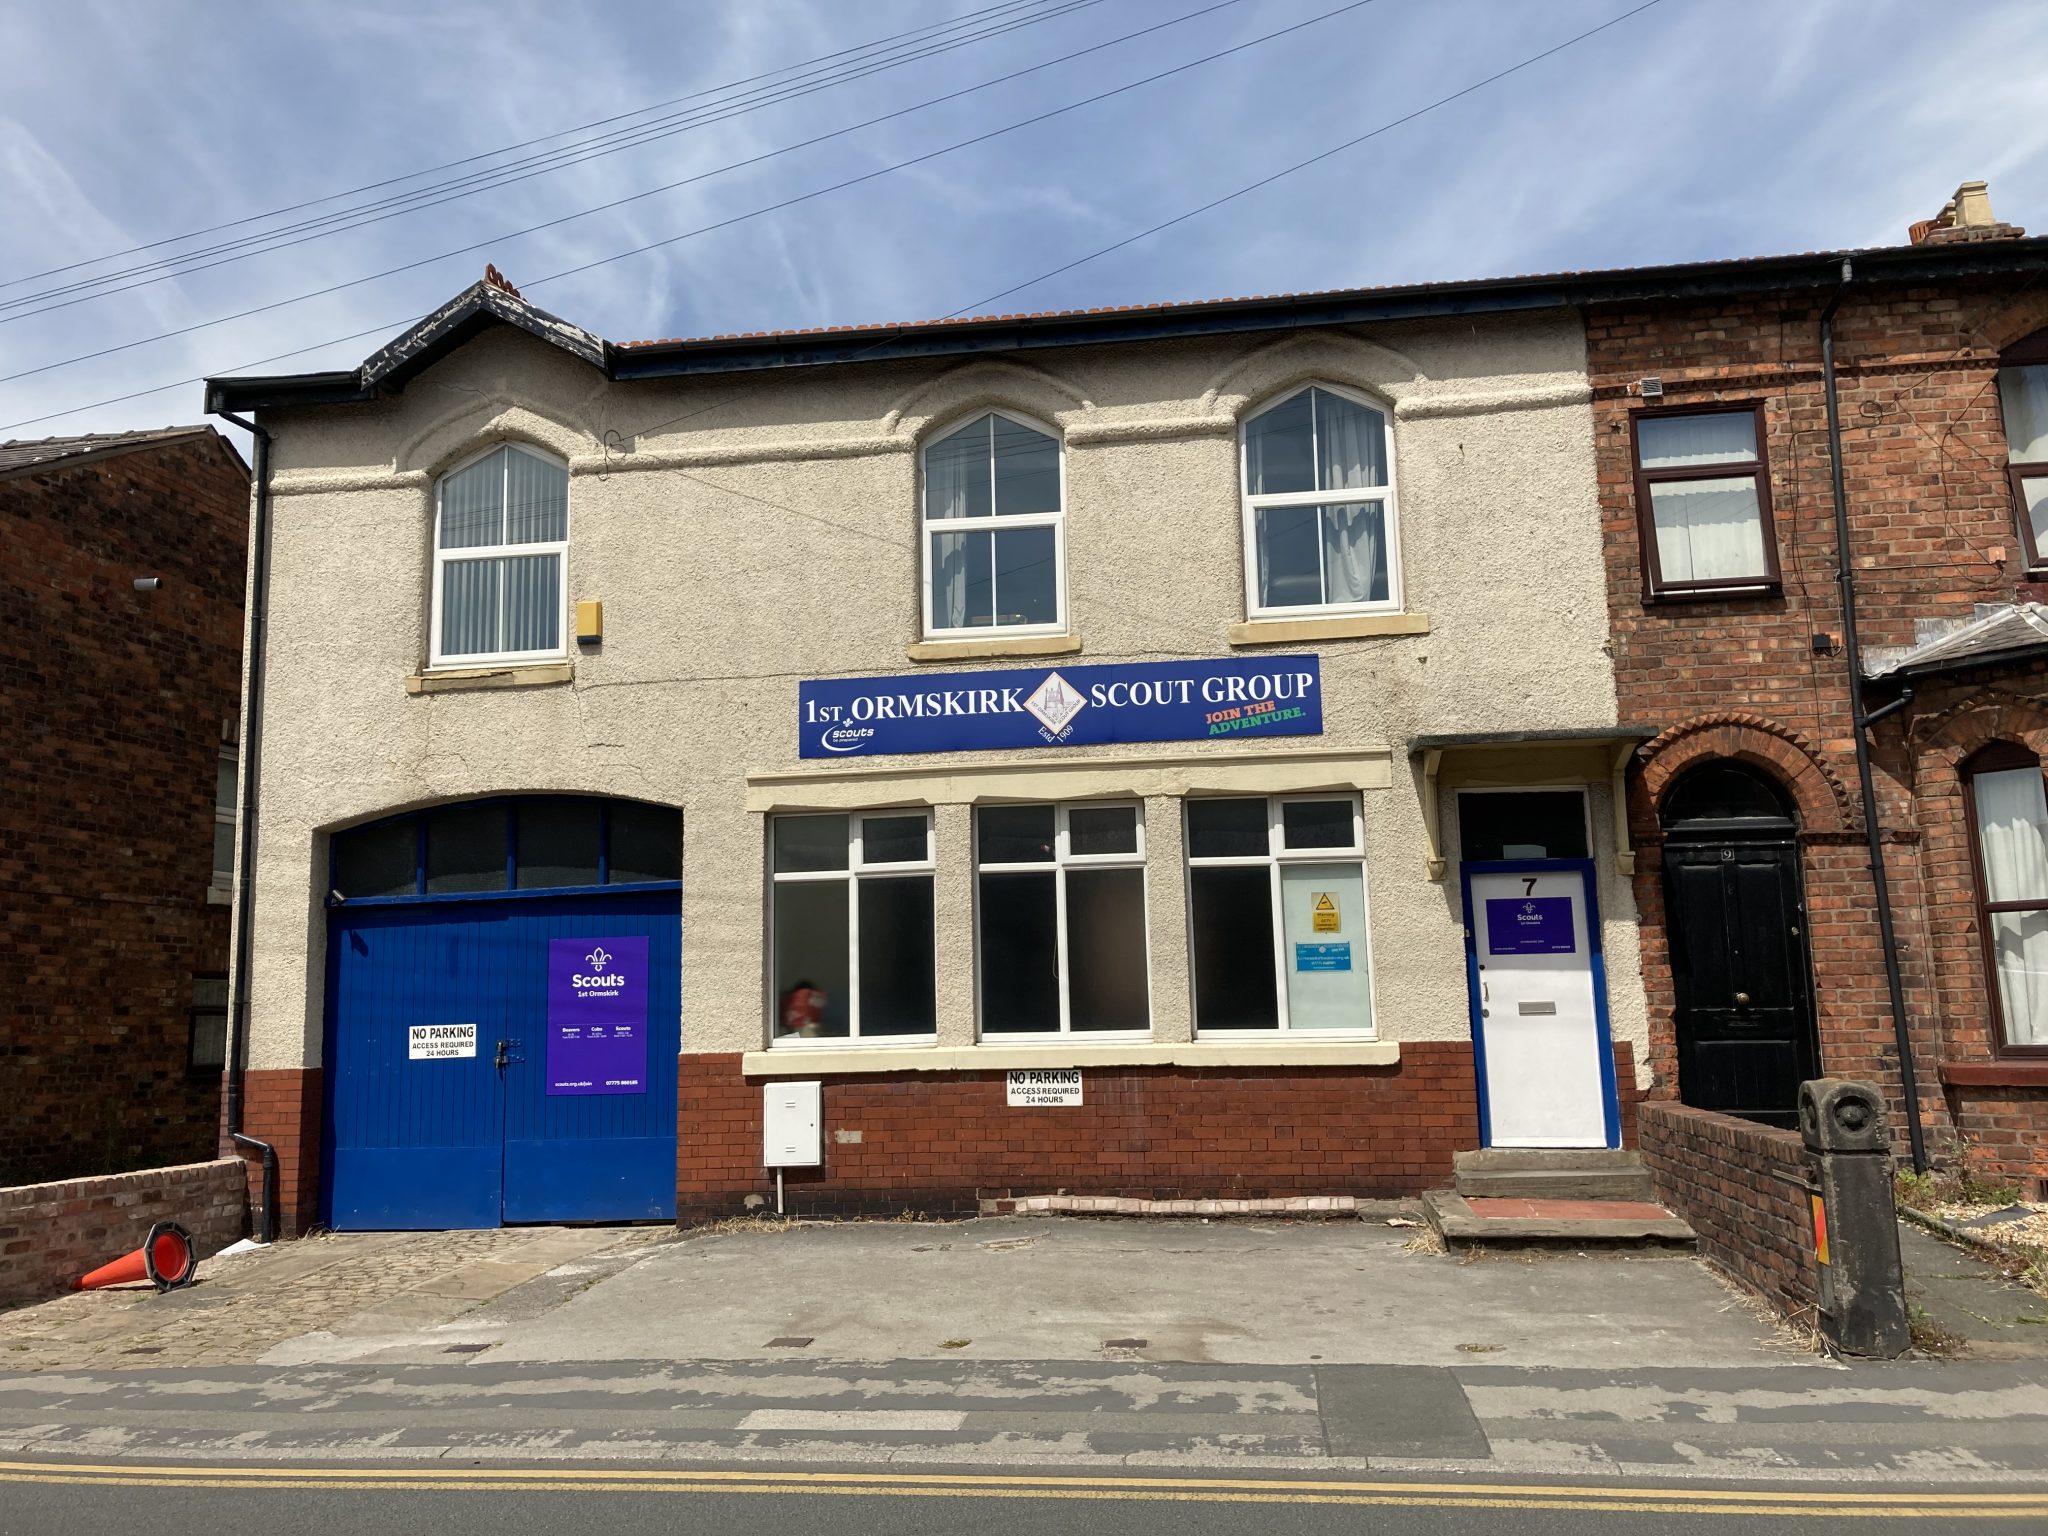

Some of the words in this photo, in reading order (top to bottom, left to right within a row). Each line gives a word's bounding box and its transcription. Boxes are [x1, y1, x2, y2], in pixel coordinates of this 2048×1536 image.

[806, 699, 843, 723] 1ST
[851, 687, 1026, 721] ORMSKIRK
[1091, 679, 1195, 709] SCOUT
[1201, 672, 1314, 703] GROUP
[1205, 708, 1241, 725] JOIN
[1243, 700, 1276, 717] THE
[1208, 706, 1307, 736] ADVENTURE.
[832, 727, 875, 739] scouts
[1038, 726, 1056, 743] Estd
[1056, 724, 1074, 743] 1909
[1723, 850, 1732, 859] 9
[1521, 877, 1538, 897] 7
[572, 973, 625, 988] Scouts
[577, 990, 589, 998] 1st
[589, 989, 619, 998] Ormskirk
[412, 1027, 427, 1040] NO
[429, 1026, 474, 1039] PARKING
[412, 1042, 439, 1050] ACCESS
[440, 1041, 474, 1049] REQUIRED
[1009, 1071, 1026, 1084] NO
[1029, 1071, 1080, 1084] PARKING
[1010, 1087, 1041, 1095] ACCESS
[1042, 1087, 1080, 1095] REQUIRED
